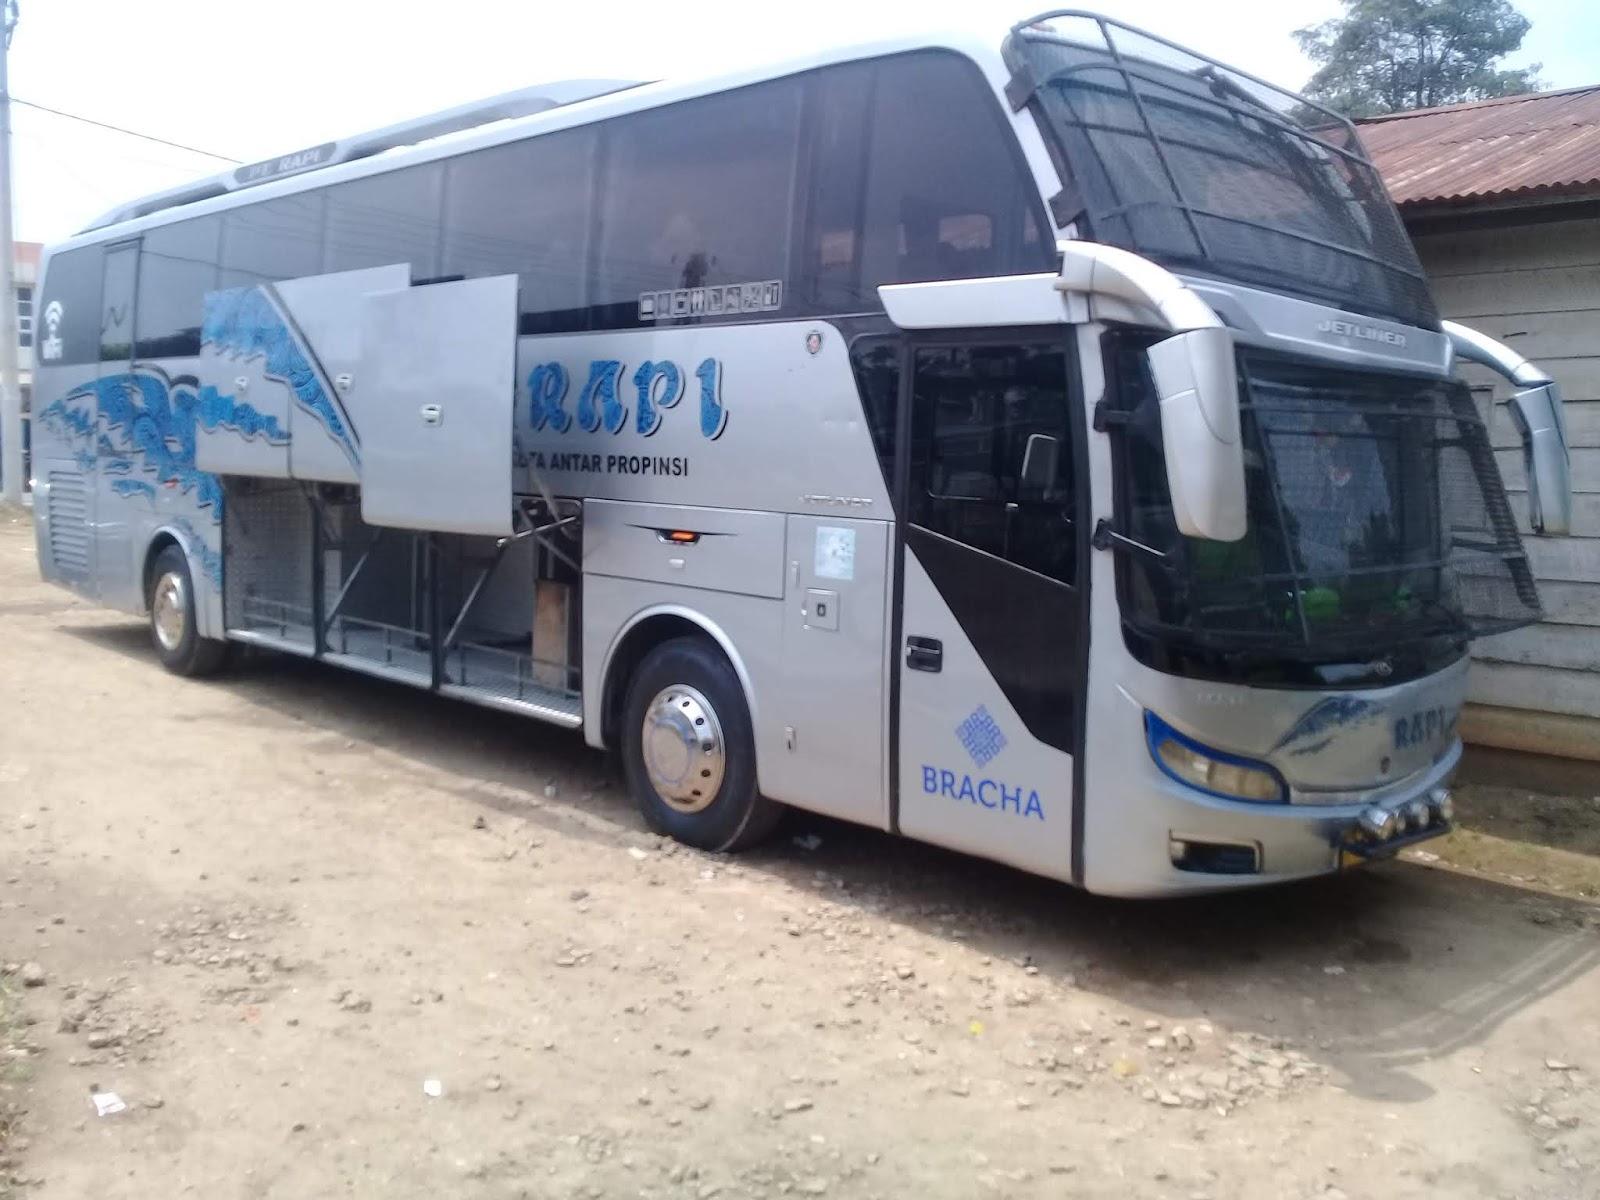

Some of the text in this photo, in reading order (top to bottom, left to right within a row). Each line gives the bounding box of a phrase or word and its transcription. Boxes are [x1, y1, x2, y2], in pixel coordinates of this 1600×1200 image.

[278, 149, 320, 171] RAPI
[1318, 319, 1407, 348] JETLINER
[527, 357, 729, 441] RAPI
[550, 452, 602, 473] ANTAR
[606, 455, 689, 477] PROPINSI
[922, 765, 1045, 821] BRACHA
